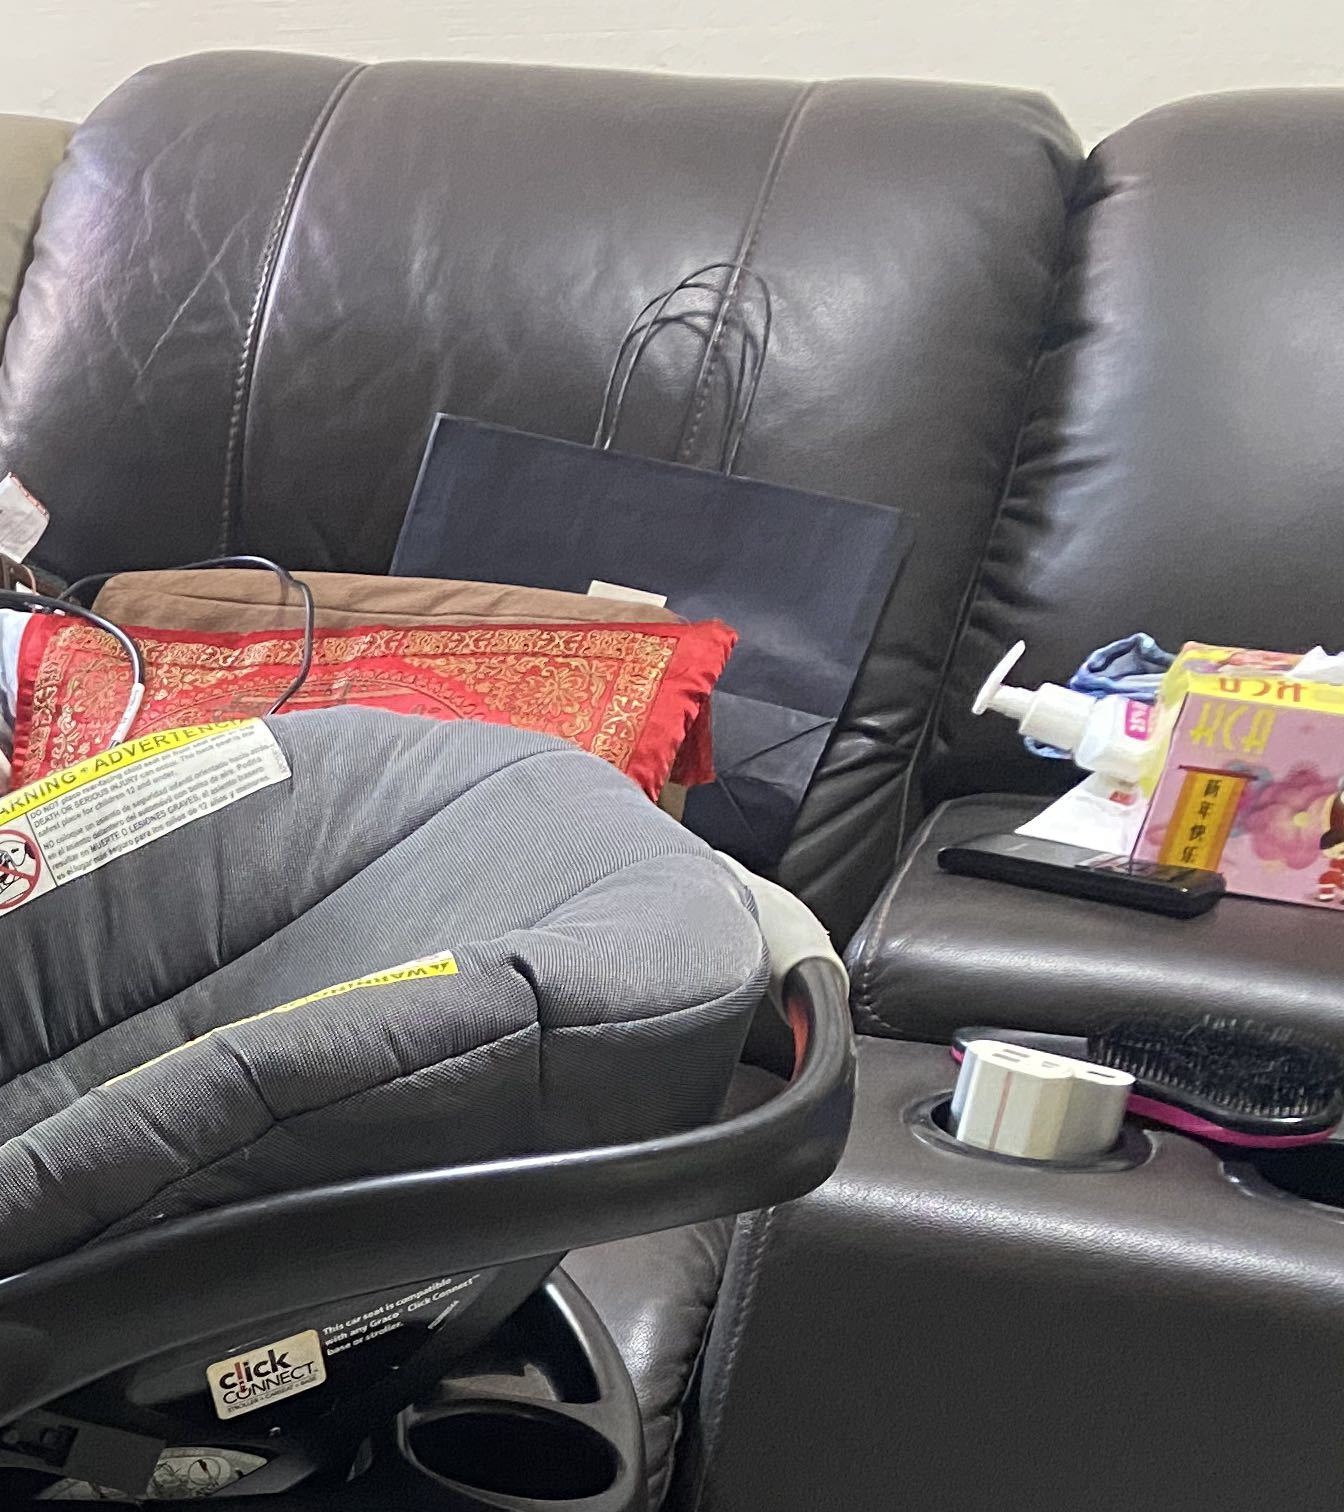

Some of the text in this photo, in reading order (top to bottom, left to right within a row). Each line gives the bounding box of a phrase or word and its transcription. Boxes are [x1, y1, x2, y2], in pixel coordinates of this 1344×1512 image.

[32, 774, 139, 828] DEATH OR SERIOUS INJURY
[125, 785, 135, 795] 12
[197, 801, 209, 813] 12
[42, 839, 55, 850] NO
[87, 830, 122, 852] MUERTE
[120, 826, 128, 836] O
[126, 808, 168, 833] LESIONES
[322, 1276, 454, 1335] This car seat is compatible
[324, 1331, 348, 1346] with
[348, 1324, 369, 1337] any
[405, 1296, 432, 1312] Click
[325, 1319, 405, 1356] base or stroller.
[218, 1349, 291, 1391] click
